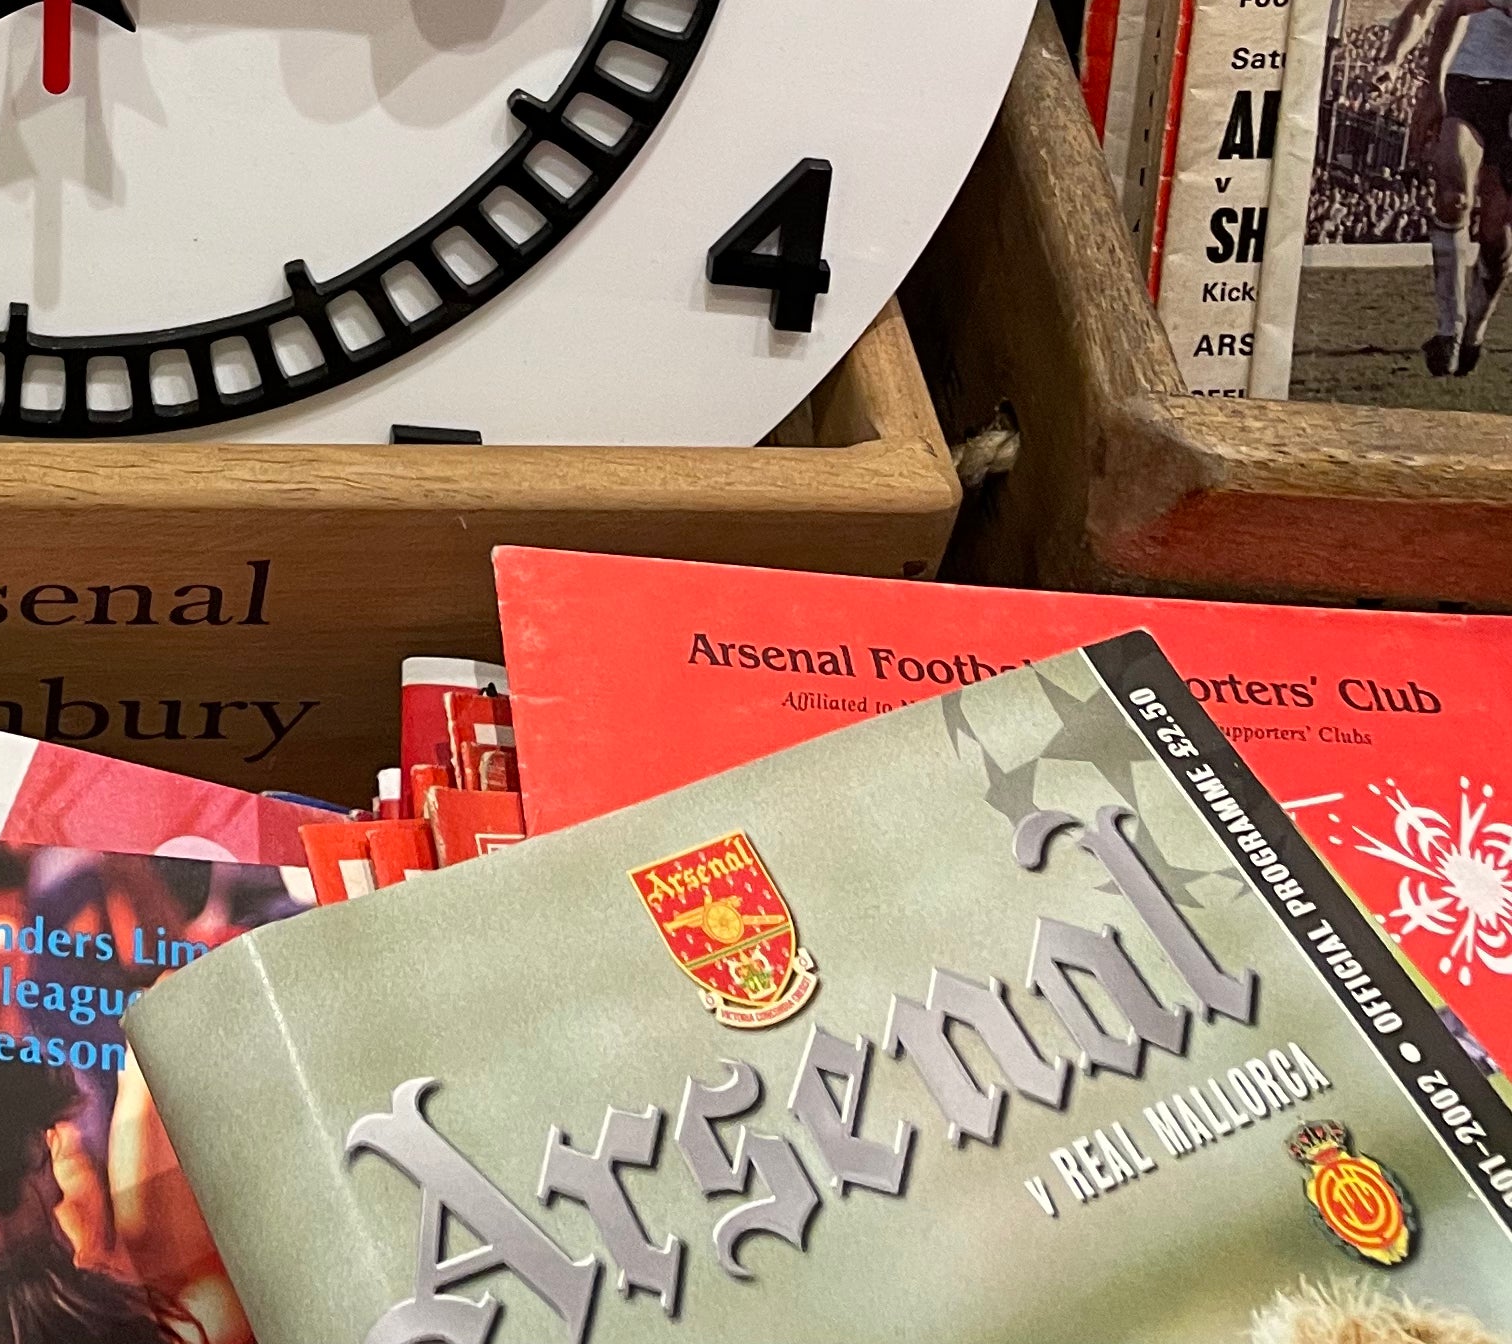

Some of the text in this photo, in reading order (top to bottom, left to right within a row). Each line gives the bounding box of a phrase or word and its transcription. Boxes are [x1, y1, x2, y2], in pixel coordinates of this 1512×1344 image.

[1231, 47, 1286, 70] Sat
[1215, 177, 1232, 193] v
[705, 156, 833, 333] 4
[688, 633, 1442, 714] Arsenal Footb orters' Club
[781, 691, 868, 713] Affiliated
[1219, 725, 1311, 743] upporters'
[1318, 726, 1372, 745] Clubs
[1129, 687, 1199, 758] £2.50
[645, 836, 754, 907] Arsenal
[1186, 763, 1317, 917] PROGRAMME
[133, 926, 222, 967] Lim
[1307, 918, 1403, 1034] OFFICIAL
[345, 802, 1259, 1344] Arsenal
[1049, 1120, 1157, 1203] REAL
[1142, 1041, 1333, 1159] MALLORCA
